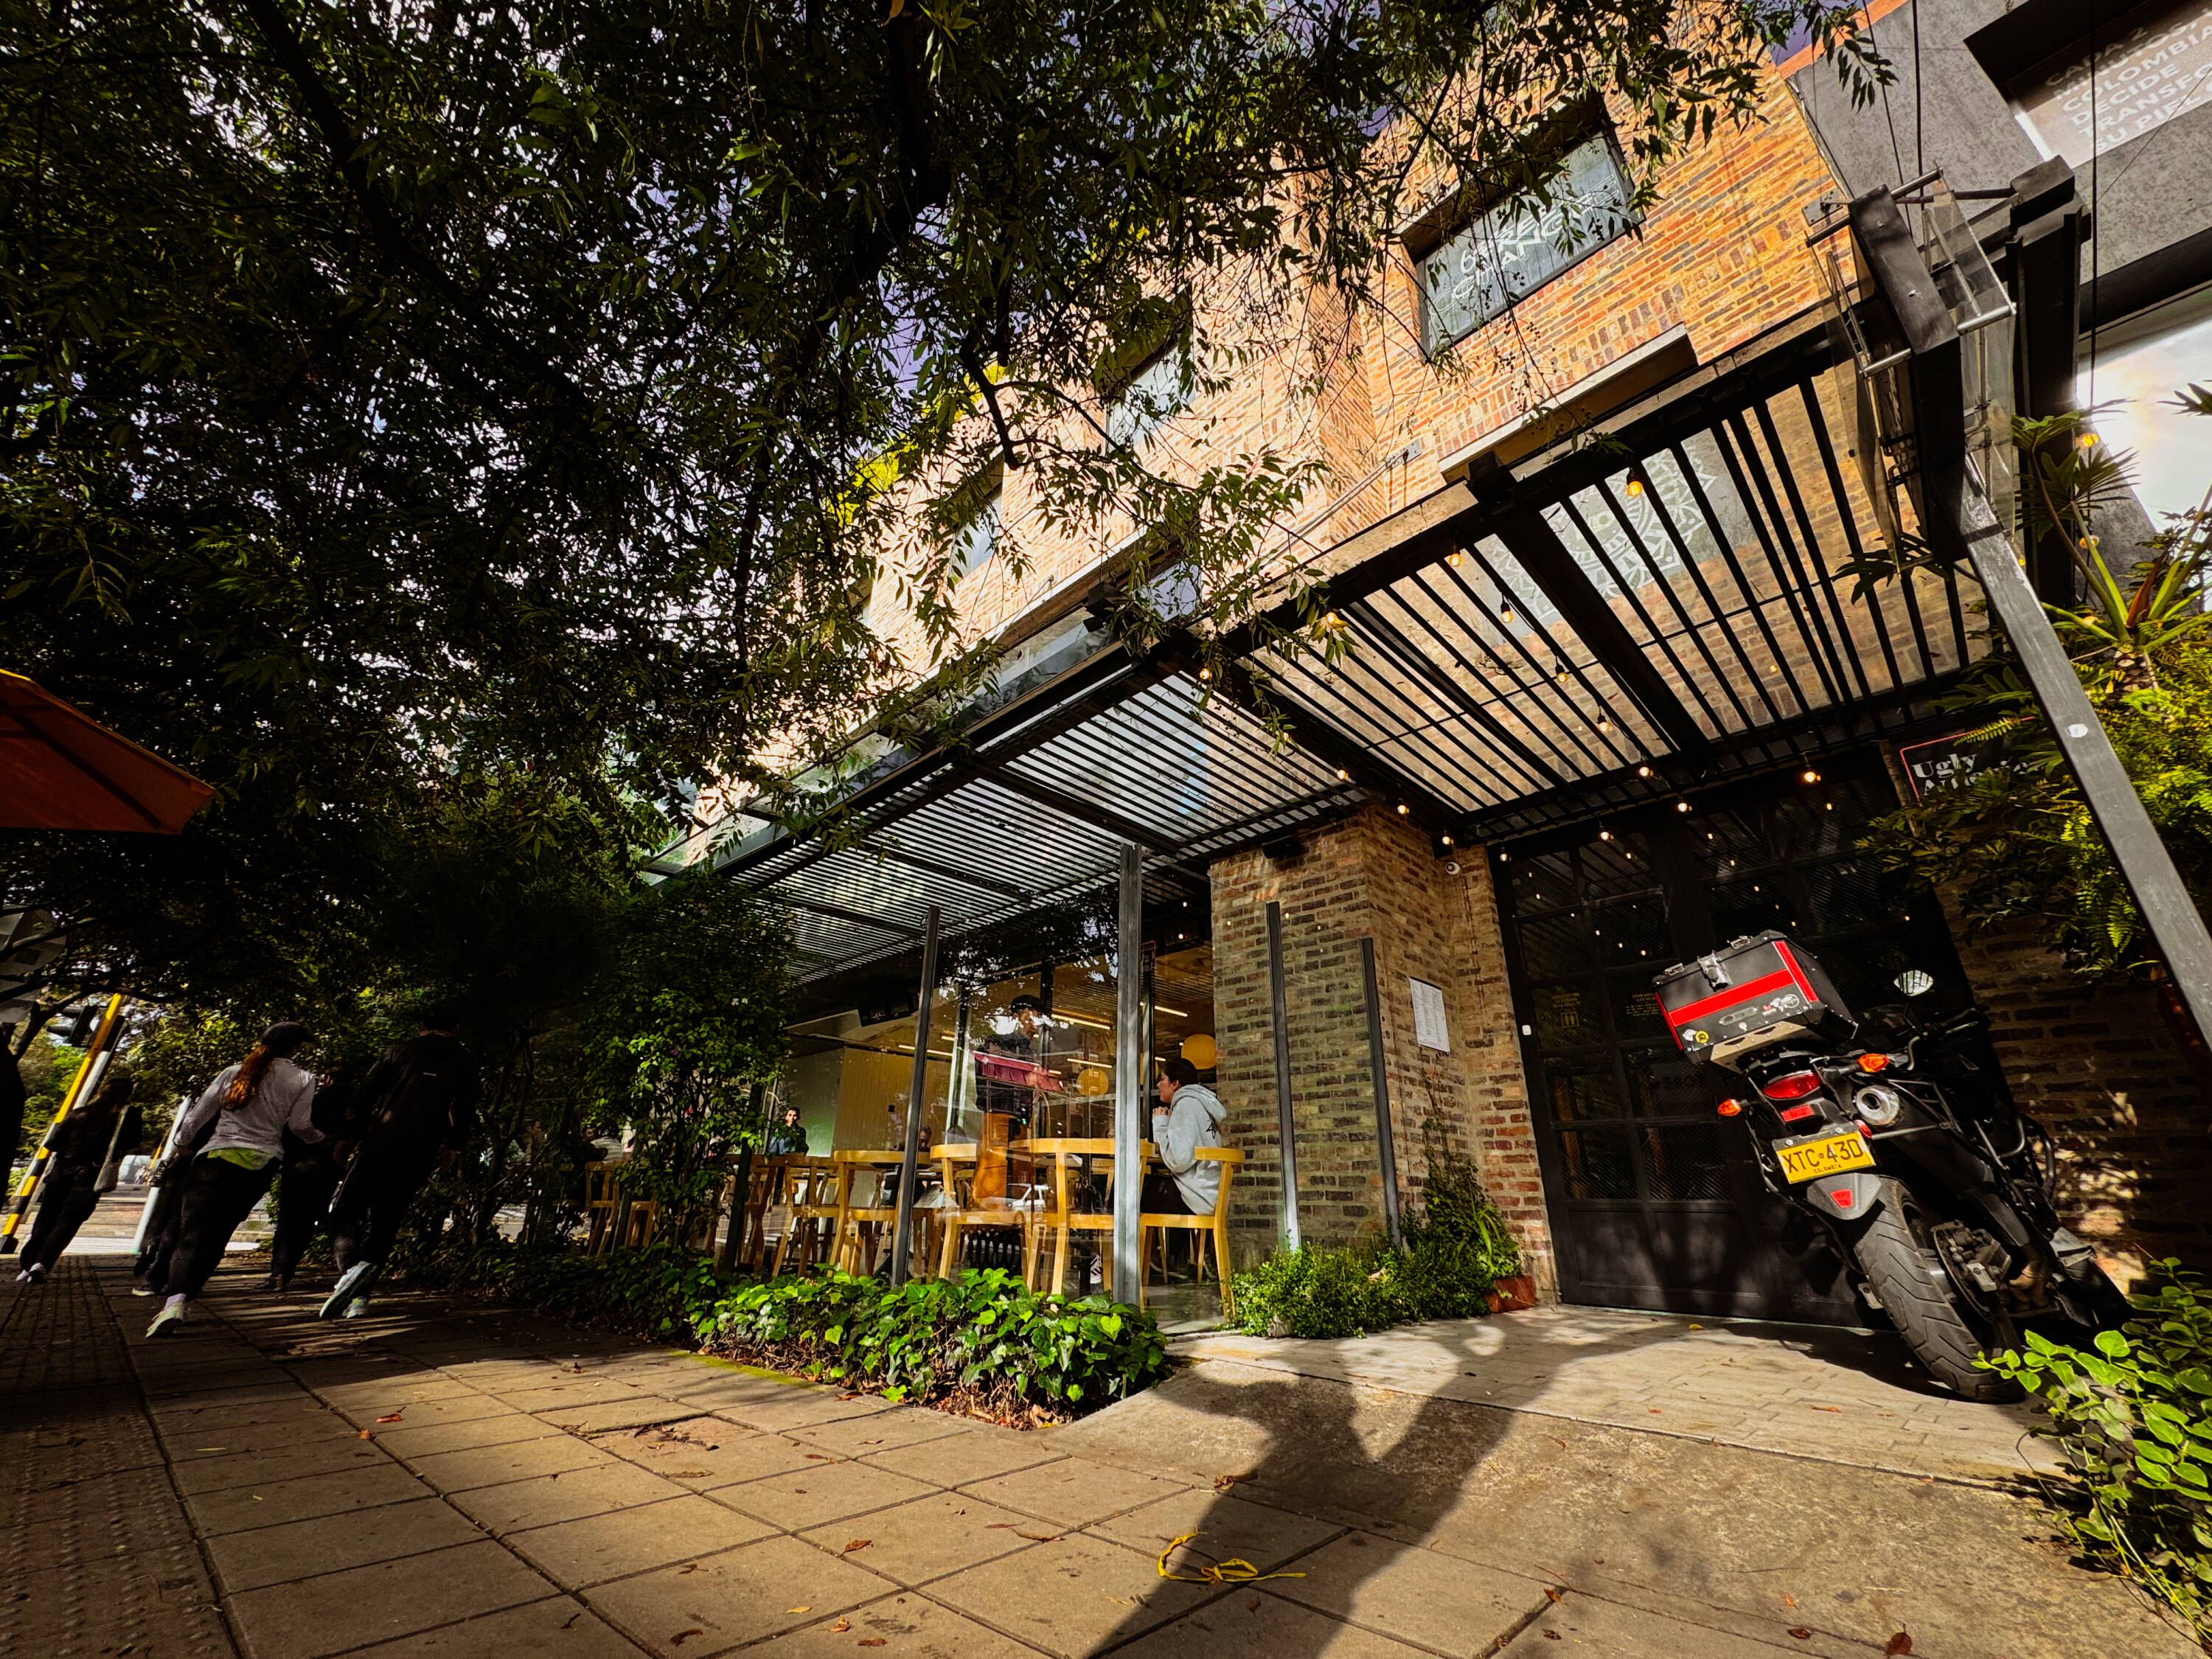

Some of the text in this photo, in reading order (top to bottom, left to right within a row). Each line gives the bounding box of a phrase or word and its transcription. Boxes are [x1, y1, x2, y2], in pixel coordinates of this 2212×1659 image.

[2045, 42, 2124, 87] CADA
[2070, 63, 2180, 127] DECIDE
[2135, 94, 2201, 131] PIEL
[1910, 753, 1978, 779] Ugly
[1813, 1164, 1842, 1174] COLOMBIA
